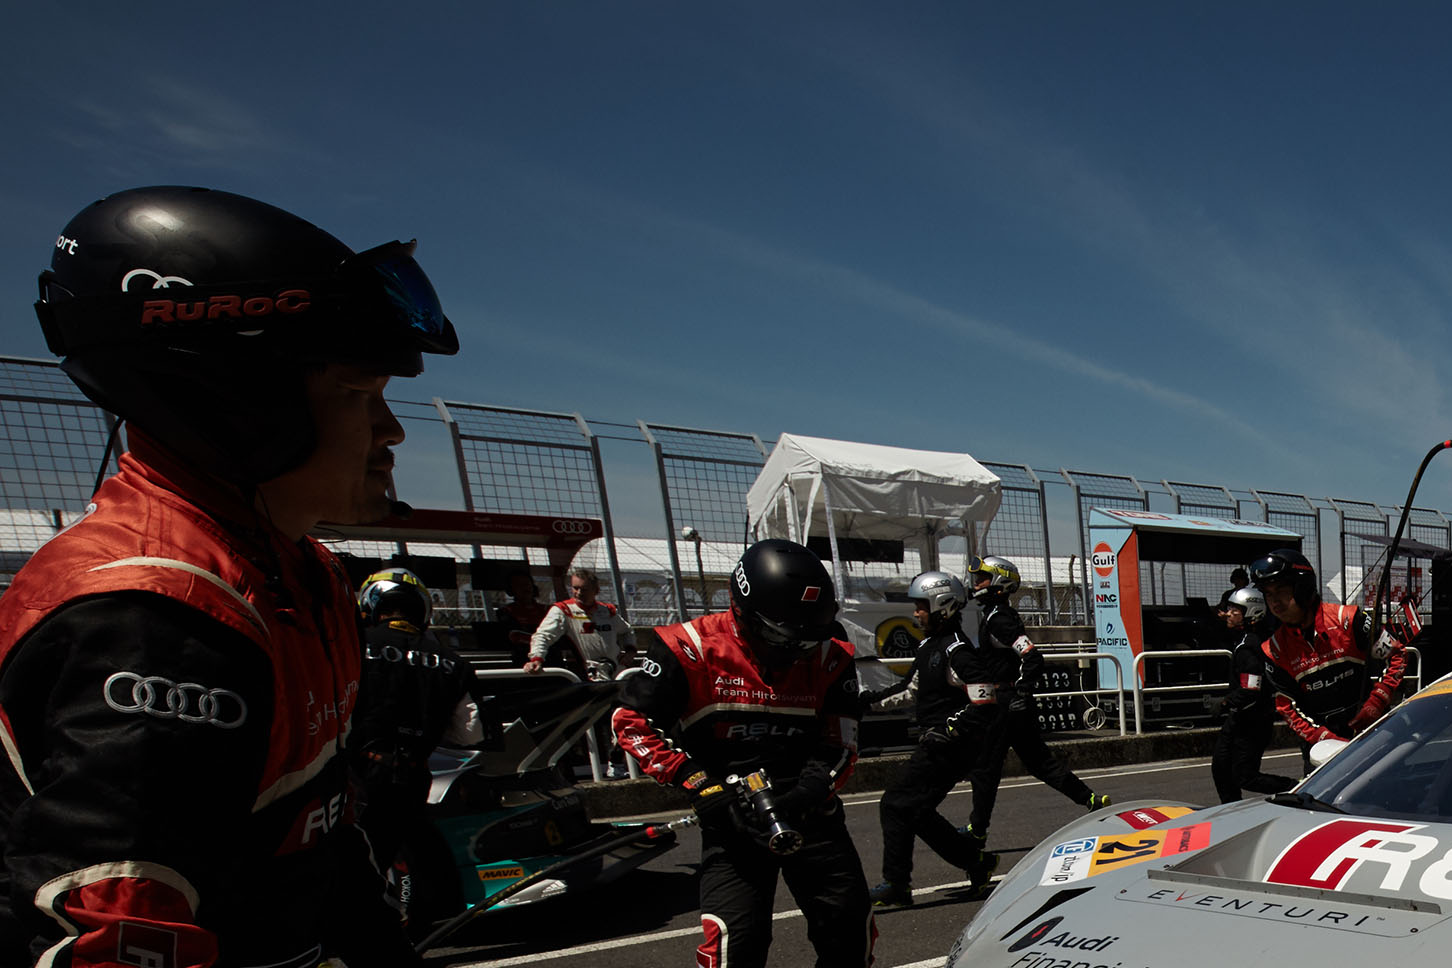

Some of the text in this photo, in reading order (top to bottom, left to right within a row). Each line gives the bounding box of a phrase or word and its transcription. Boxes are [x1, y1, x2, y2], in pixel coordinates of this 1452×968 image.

[56, 234, 79, 256] ort
[1092, 554, 1116, 567] Gulf
[1096, 637, 1129, 648] PACIFIC
[364, 645, 457, 675] LOTUS
[714, 675, 745, 686] Audi
[715, 686, 749, 699] Team
[1095, 839, 1160, 866] 21
[482, 868, 522, 880] MAVIC
[1147, 889, 1370, 927] EVENTURI
[1039, 931, 1120, 952] Audi
